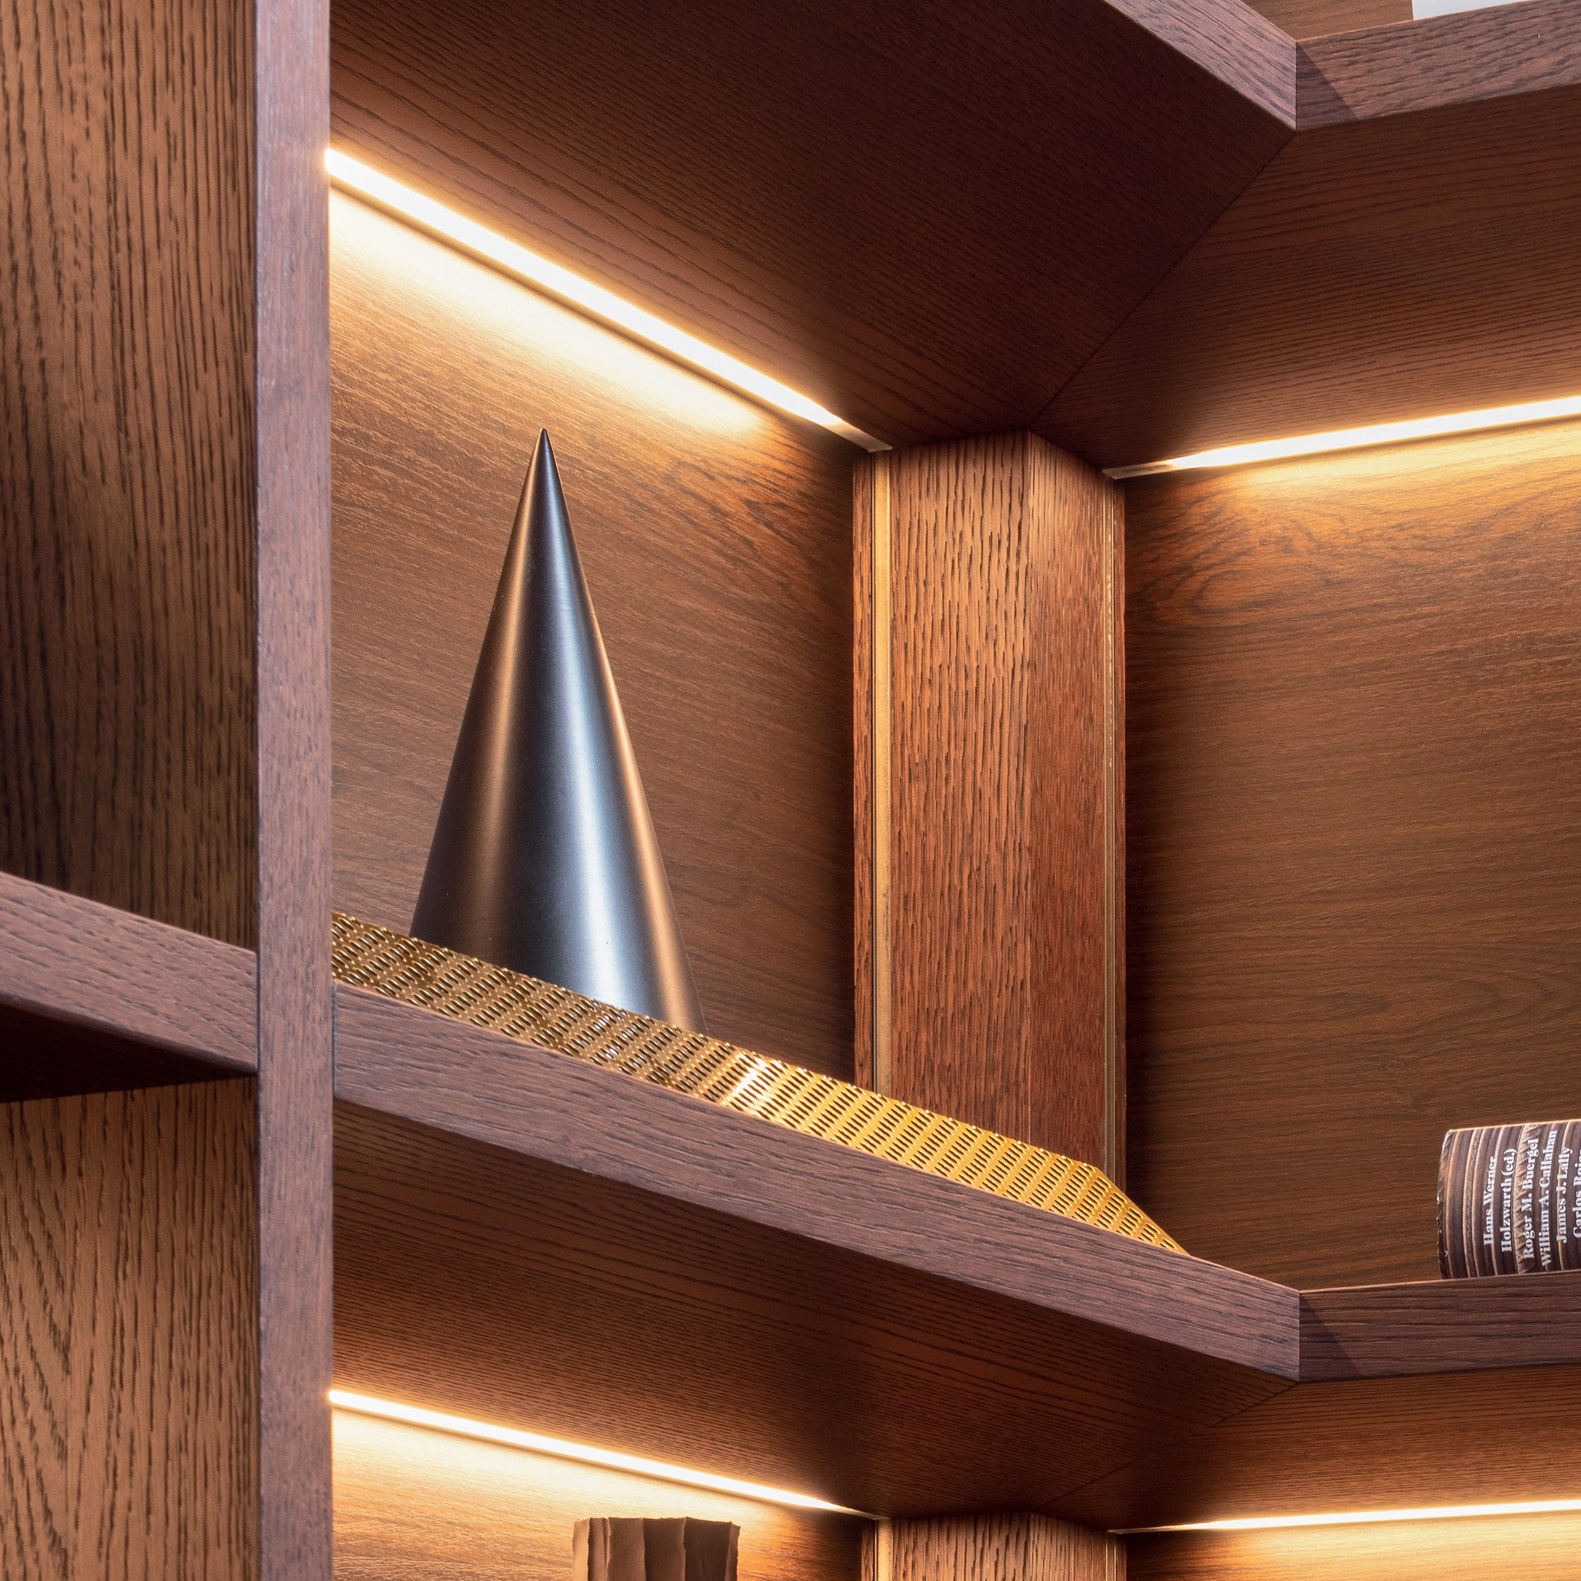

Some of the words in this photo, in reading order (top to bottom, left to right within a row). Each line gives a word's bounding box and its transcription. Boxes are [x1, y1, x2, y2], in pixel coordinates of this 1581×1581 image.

[1501, 1148, 1517, 1176] (ed.)
[1522, 1138, 1539, 1190] Buergel
[1539, 1130, 1557, 1188] Callahan
[1557, 1146, 1573, 1180] Lally
[1484, 1156, 1496, 1205] Werner
[1539, 1191, 1549, 1208] A.
[1556, 1181, 1567, 1194] J.
[1500, 1177, 1513, 1252] Holzwarth
[1522, 1193, 1533, 1211] M.
[1556, 1200, 1567, 1243] James
[1483, 1204, 1494, 1245] Hans
[1521, 1217, 1535, 1259] Roger
[1539, 1208, 1552, 1266] William
